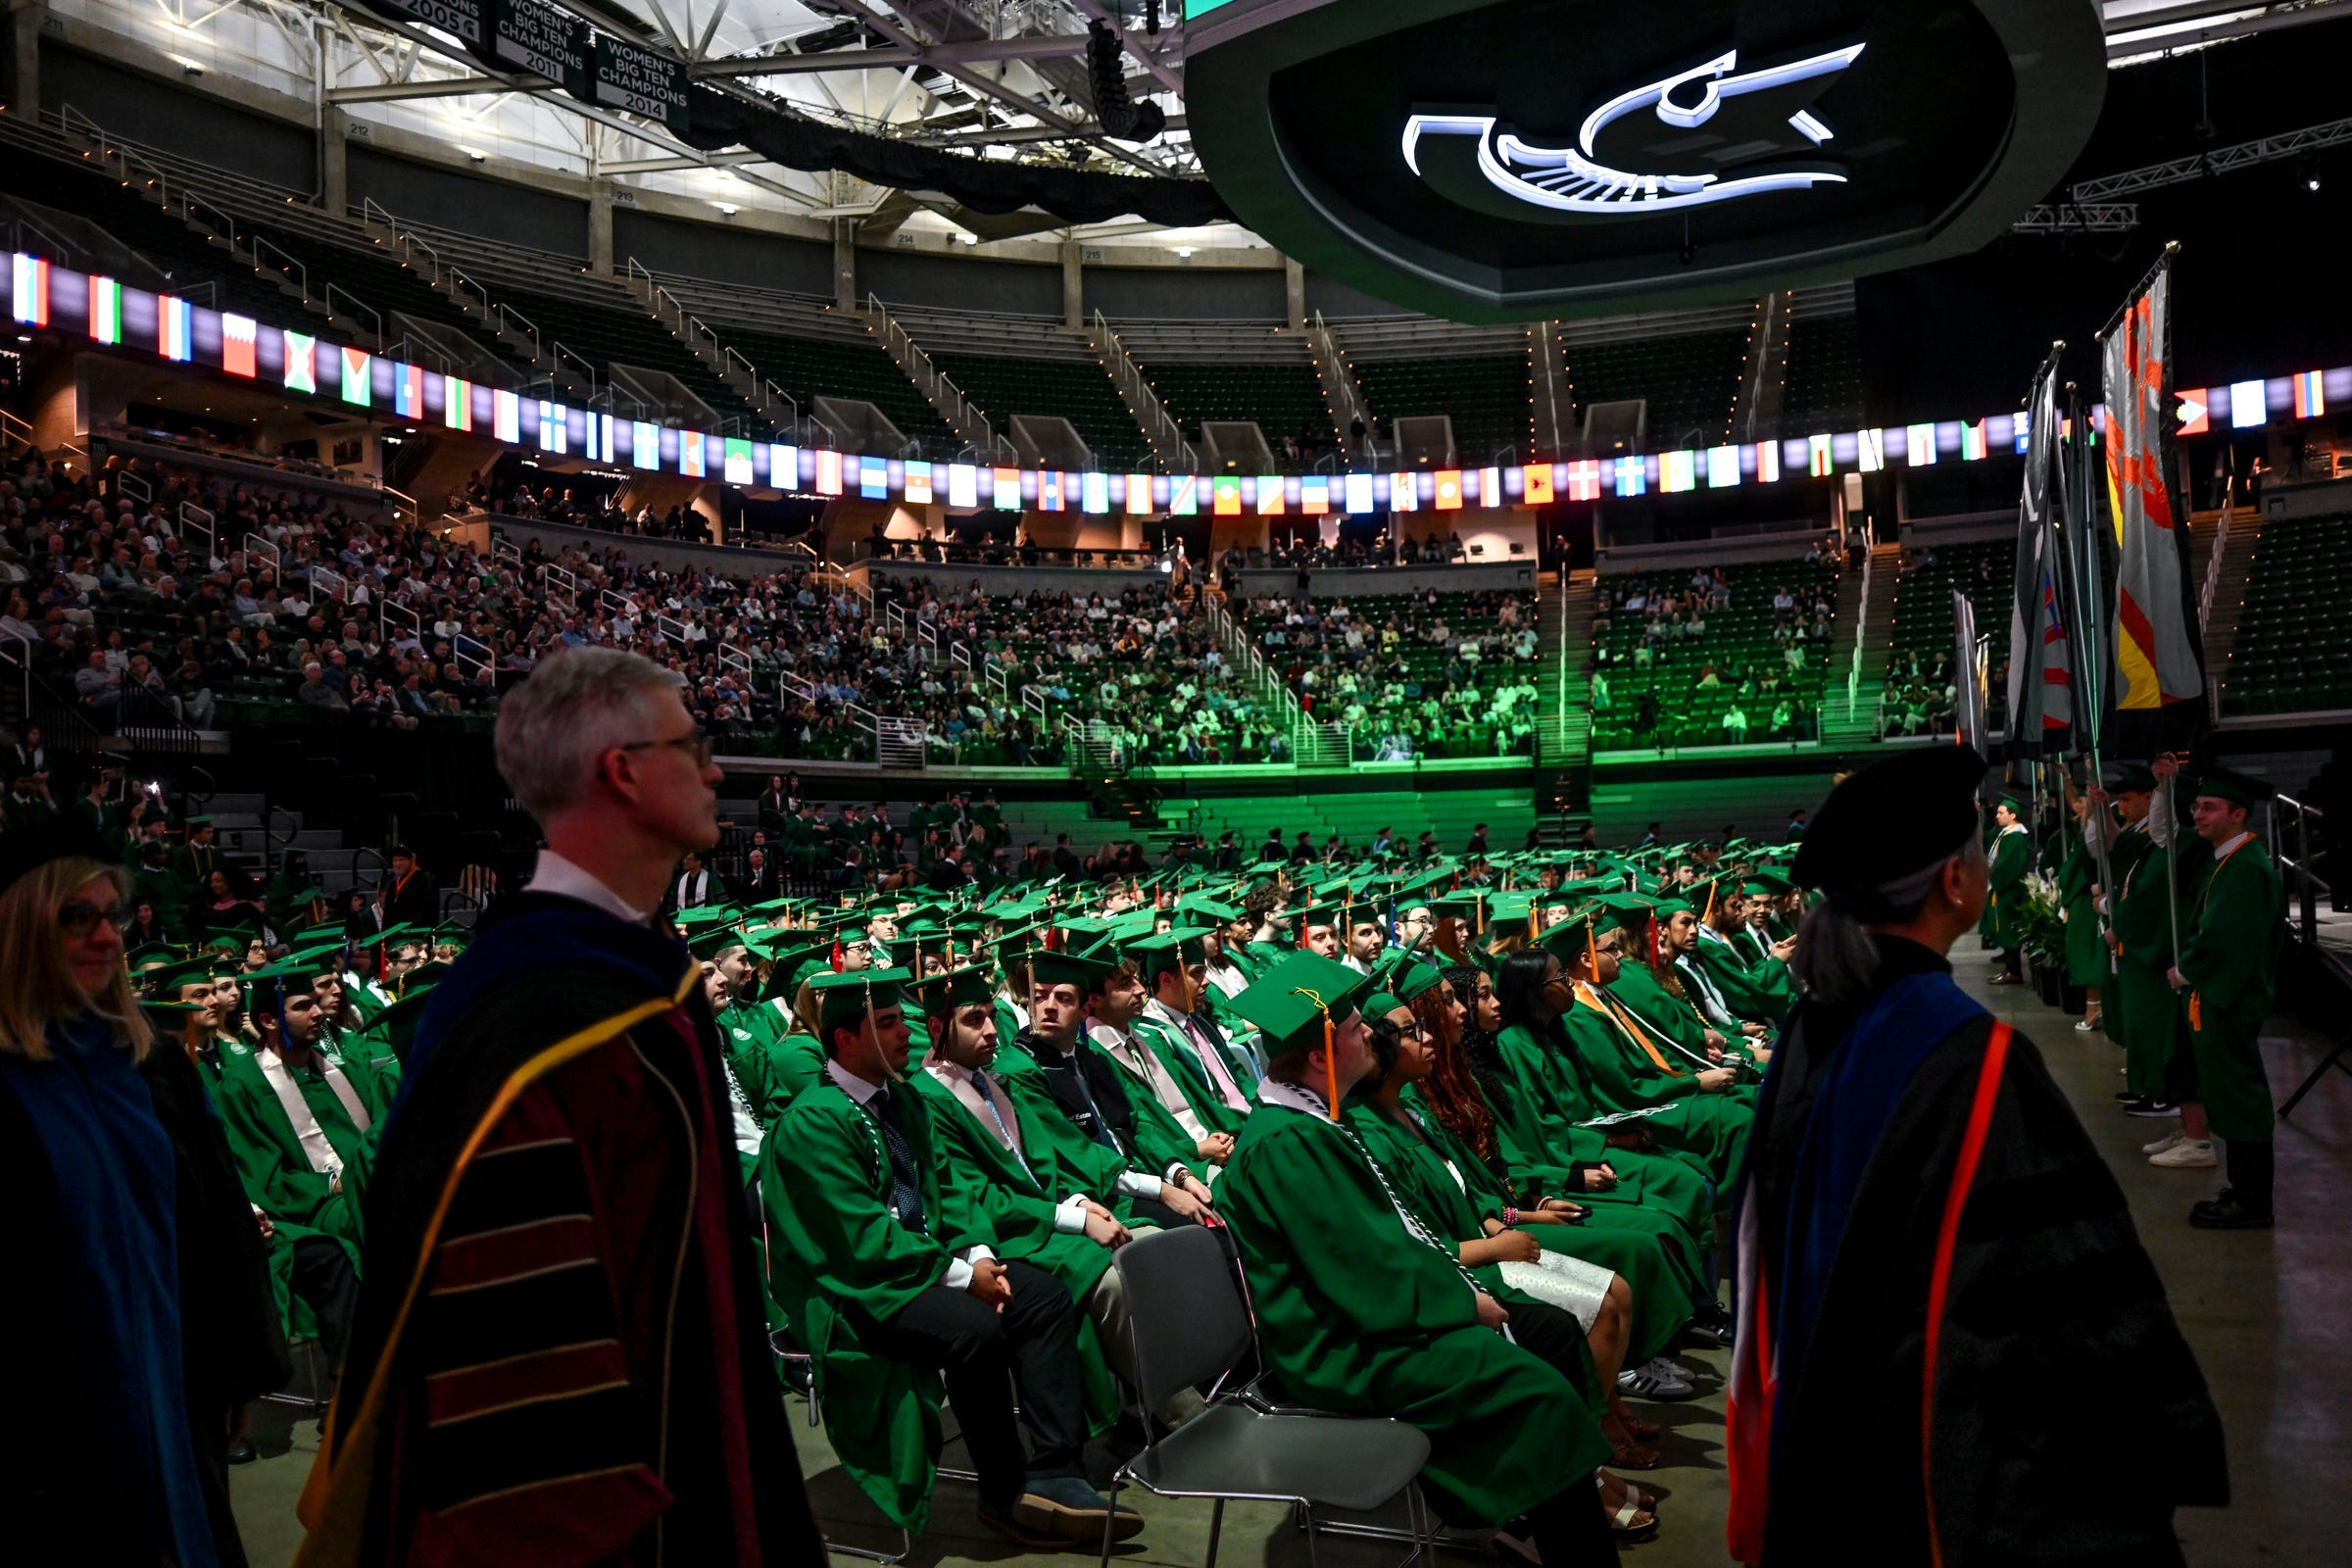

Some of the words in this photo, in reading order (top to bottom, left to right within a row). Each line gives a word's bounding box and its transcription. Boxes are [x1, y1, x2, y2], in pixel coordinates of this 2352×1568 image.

[408, 0, 459, 30] 2005
[510, 0, 573, 36] WOMEN'S
[498, 20, 584, 71] CHAMPIONS
[514, 12, 538, 33] BIG
[542, 25, 567, 49] TEN
[526, 52, 558, 78] 2011
[608, 40, 676, 76] WOMEN'S
[599, 67, 687, 107] CHAMPIONS
[615, 58, 639, 77] BIG
[643, 69, 670, 89] TEN
[625, 93, 662, 118] 2014
[351, 122, 368, 136] 212
[617, 191, 633, 202] 213
[899, 234, 913, 243] 214
[1086, 250, 1101, 259] 215
